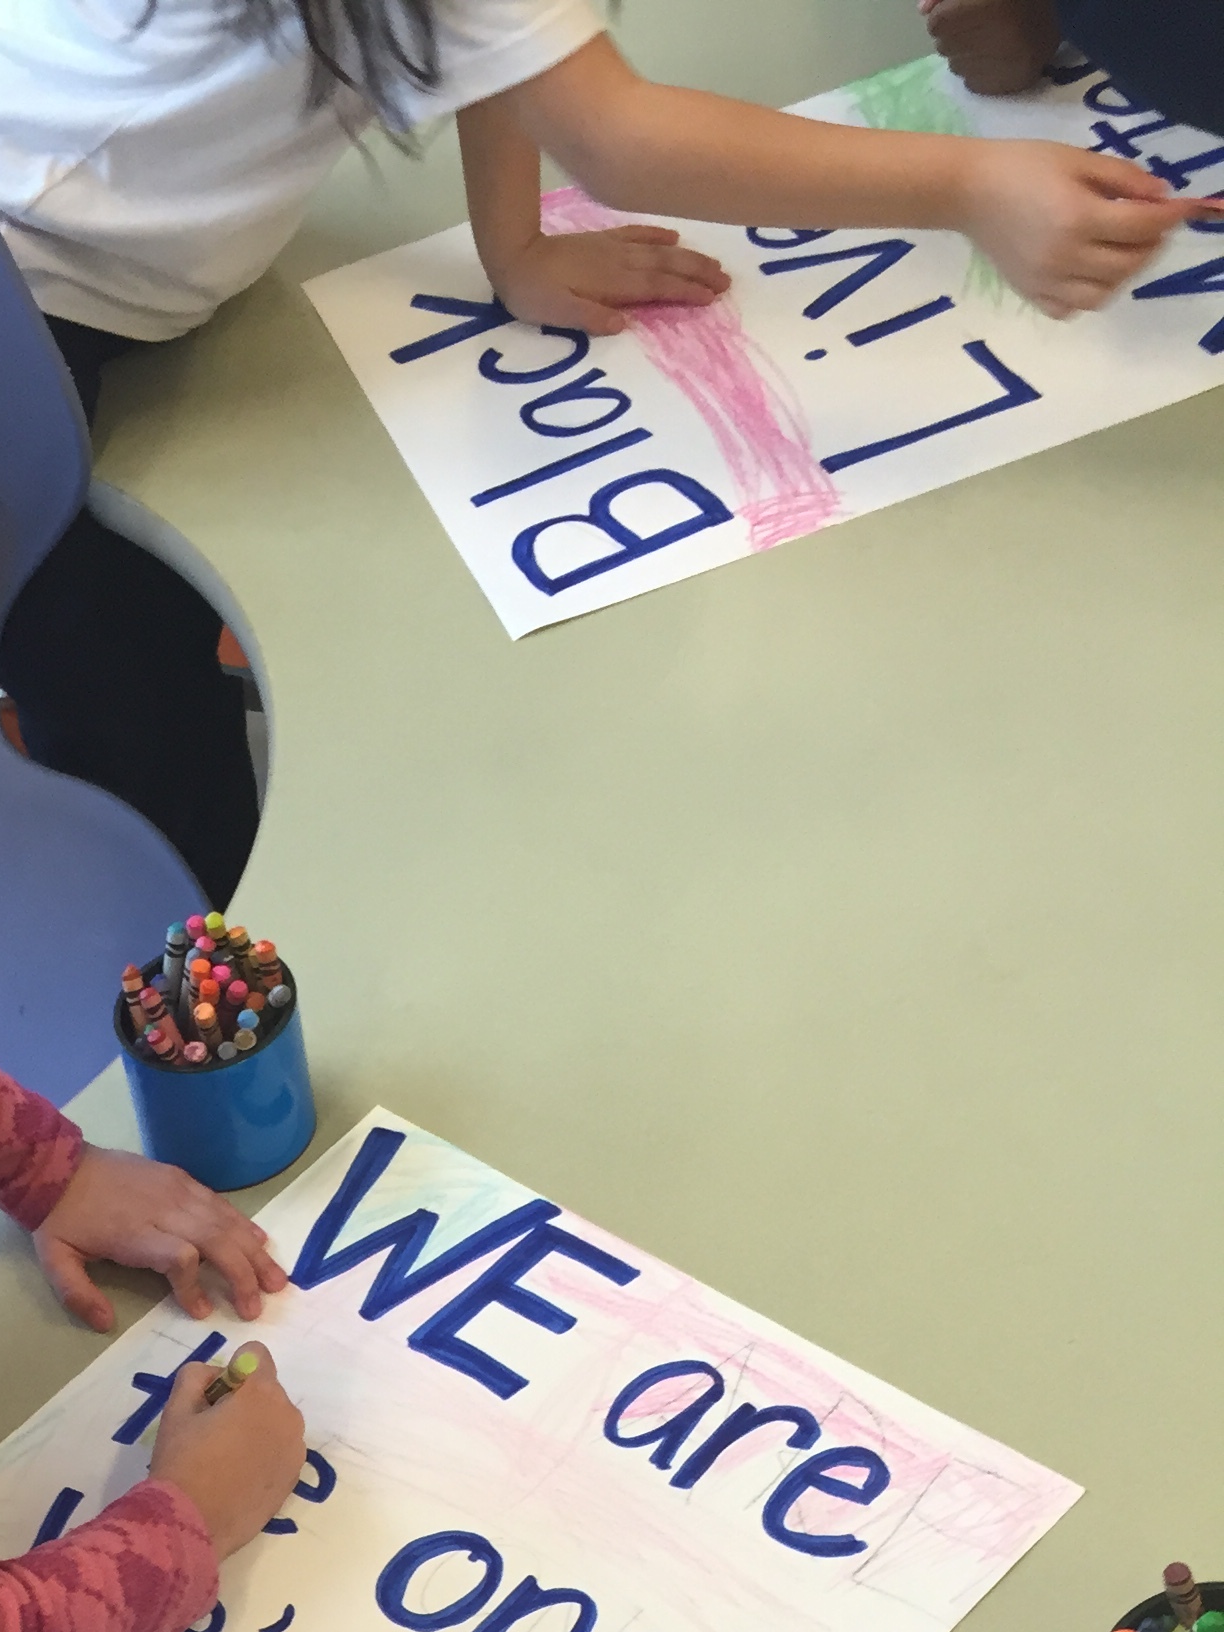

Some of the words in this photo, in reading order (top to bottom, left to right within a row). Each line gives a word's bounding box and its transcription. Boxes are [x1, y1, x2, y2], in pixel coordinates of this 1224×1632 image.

[389, 291, 734, 598] Black
[288, 1127, 642, 1400] WE
[602, 1359, 892, 1558] are
